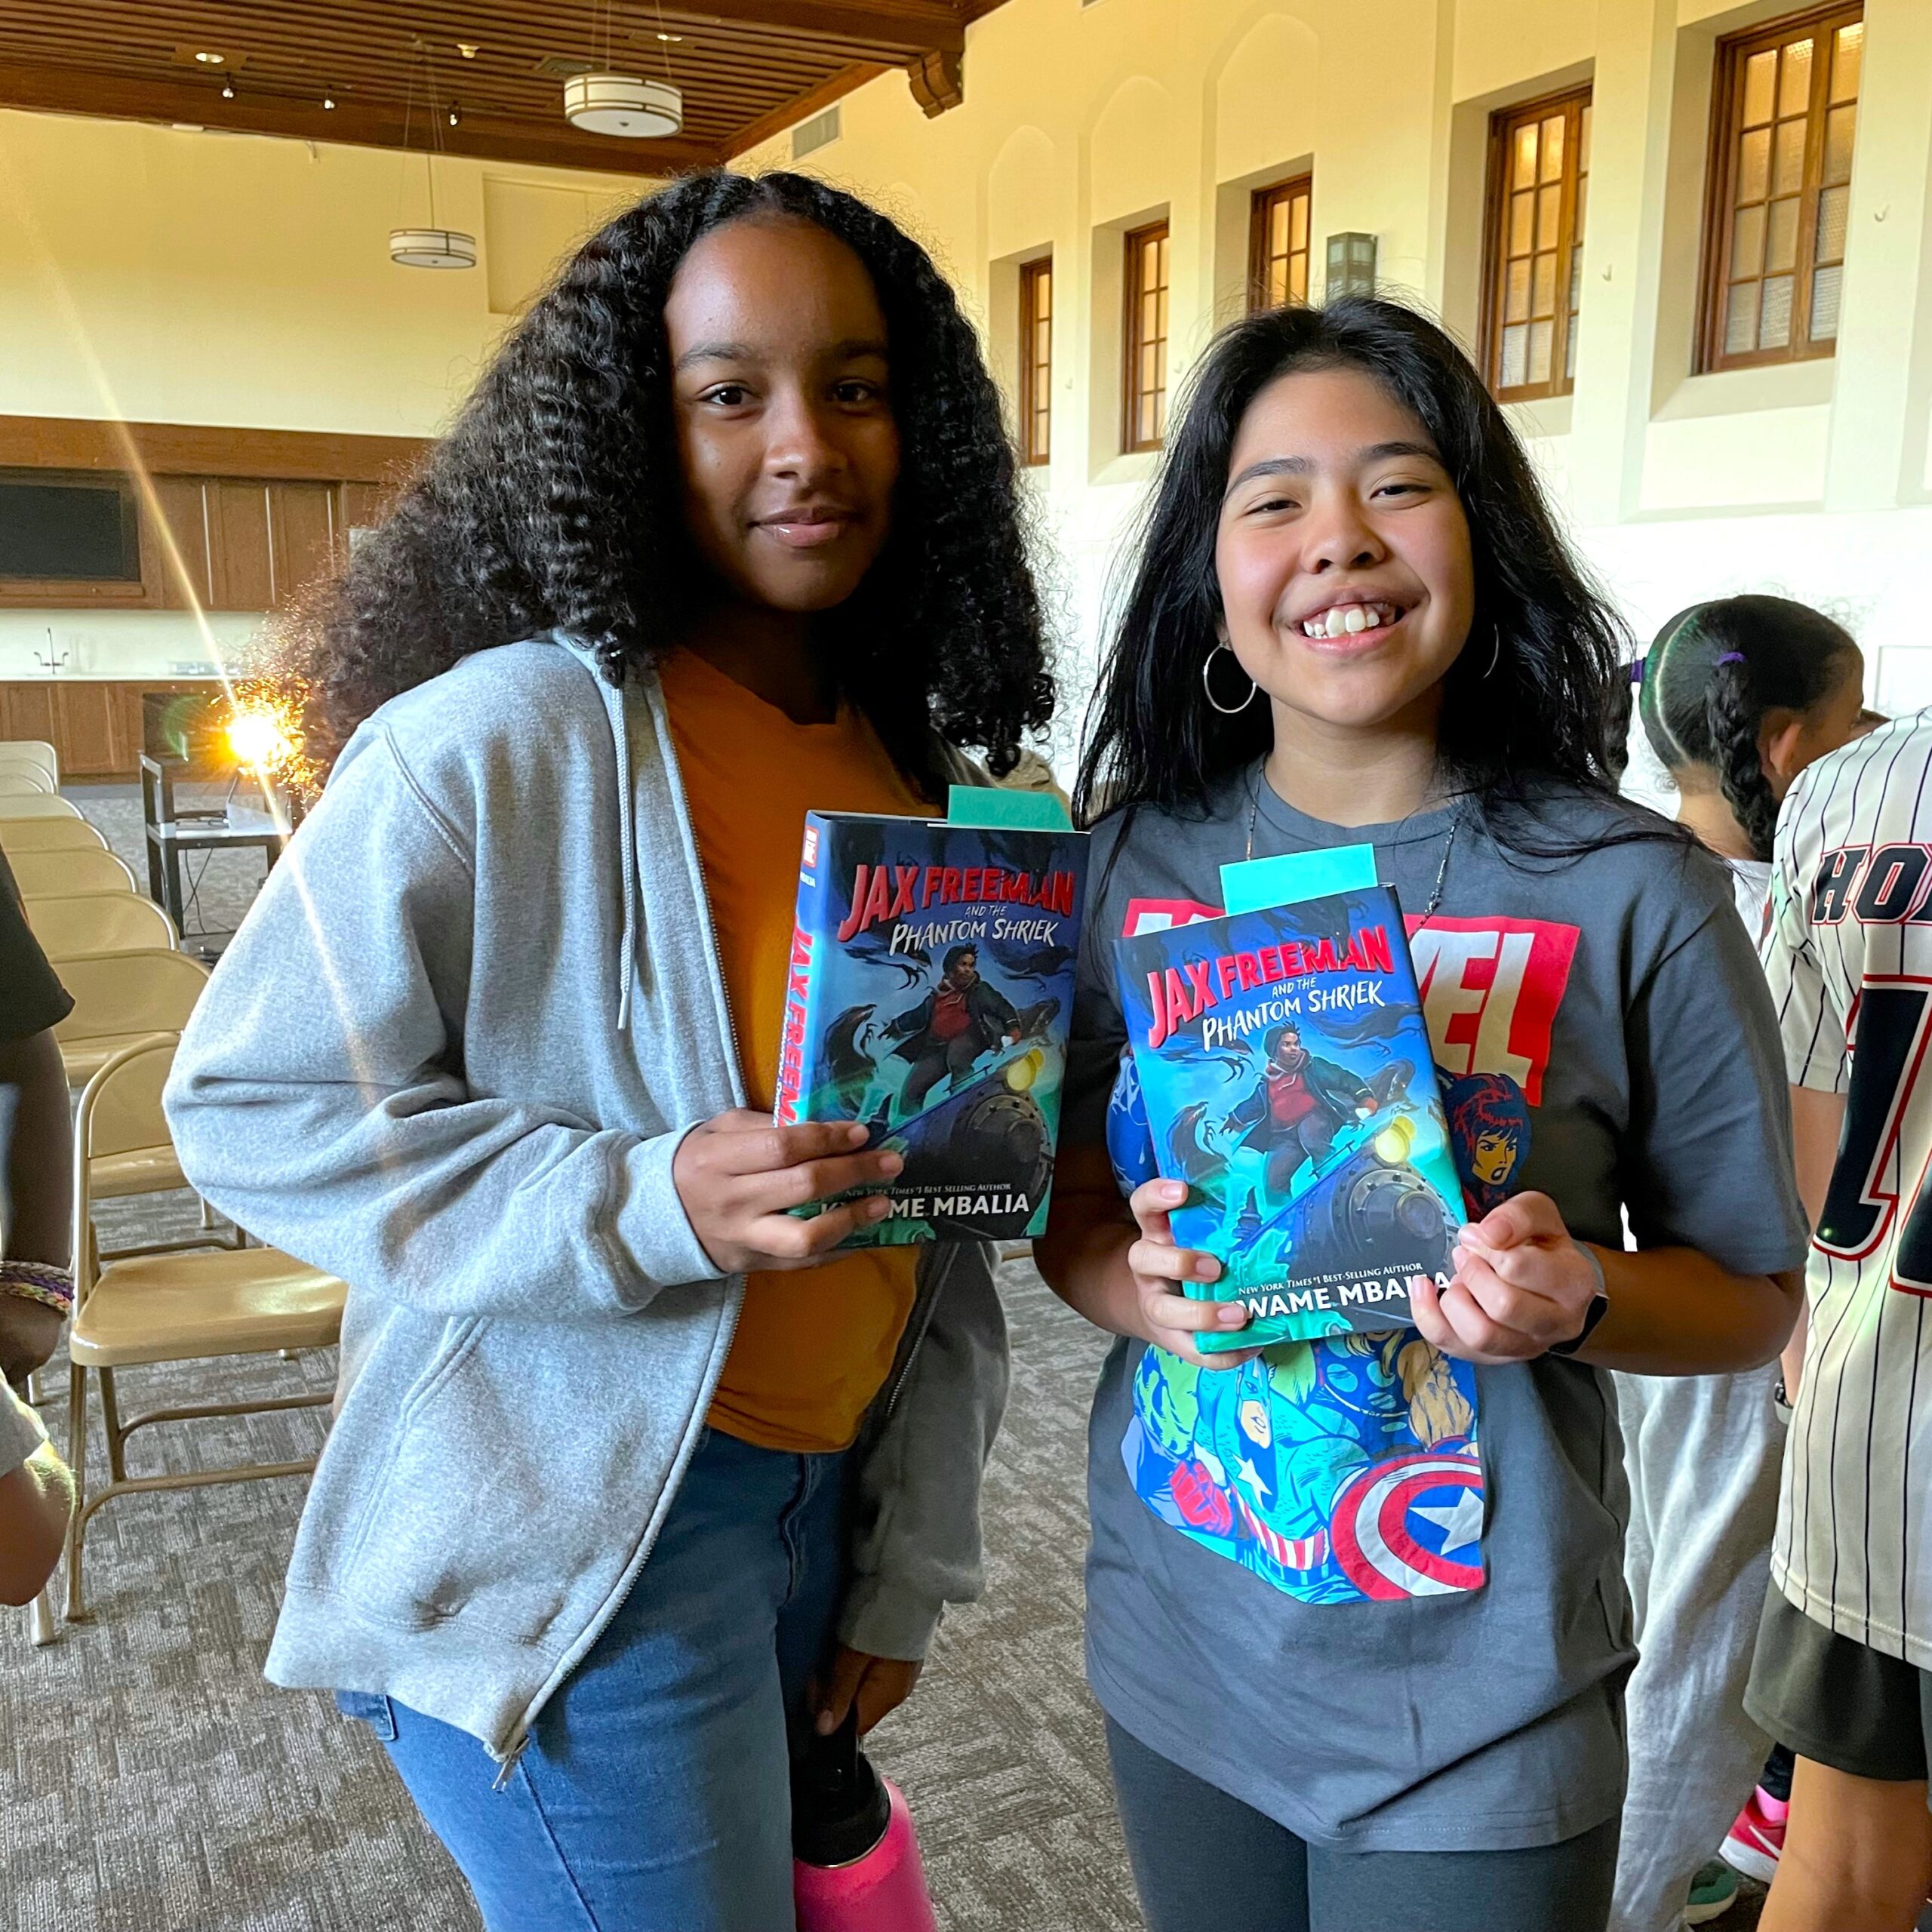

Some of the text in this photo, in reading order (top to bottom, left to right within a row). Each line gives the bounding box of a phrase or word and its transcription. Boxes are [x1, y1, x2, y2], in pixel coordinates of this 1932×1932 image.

[837, 864, 1075, 942] JAX FREEMAN
[965, 904, 1007, 918] AND THE
[888, 918, 1060, 957] PHANTOM SHRIEK
[1147, 925, 1394, 1048] JAX FREEMAN
[1272, 977, 1316, 998] AND THE
[1202, 980, 1386, 1053] PHANTOM SHRIEK
[889, 1186, 914, 1195] TIMES
[977, 1183, 1011, 1192] AUTHOR
[932, 1193, 1029, 1217] MBALIA
[1238, 1286, 1259, 1296] NEW
[1260, 1282, 1284, 1292] YORK
[1285, 1278, 1312, 1288] TIMES
[1322, 1268, 1381, 1284] BEST-SELLING
[1383, 1263, 1423, 1275] AUTHOR
[1231, 1287, 1332, 1318] WAME
